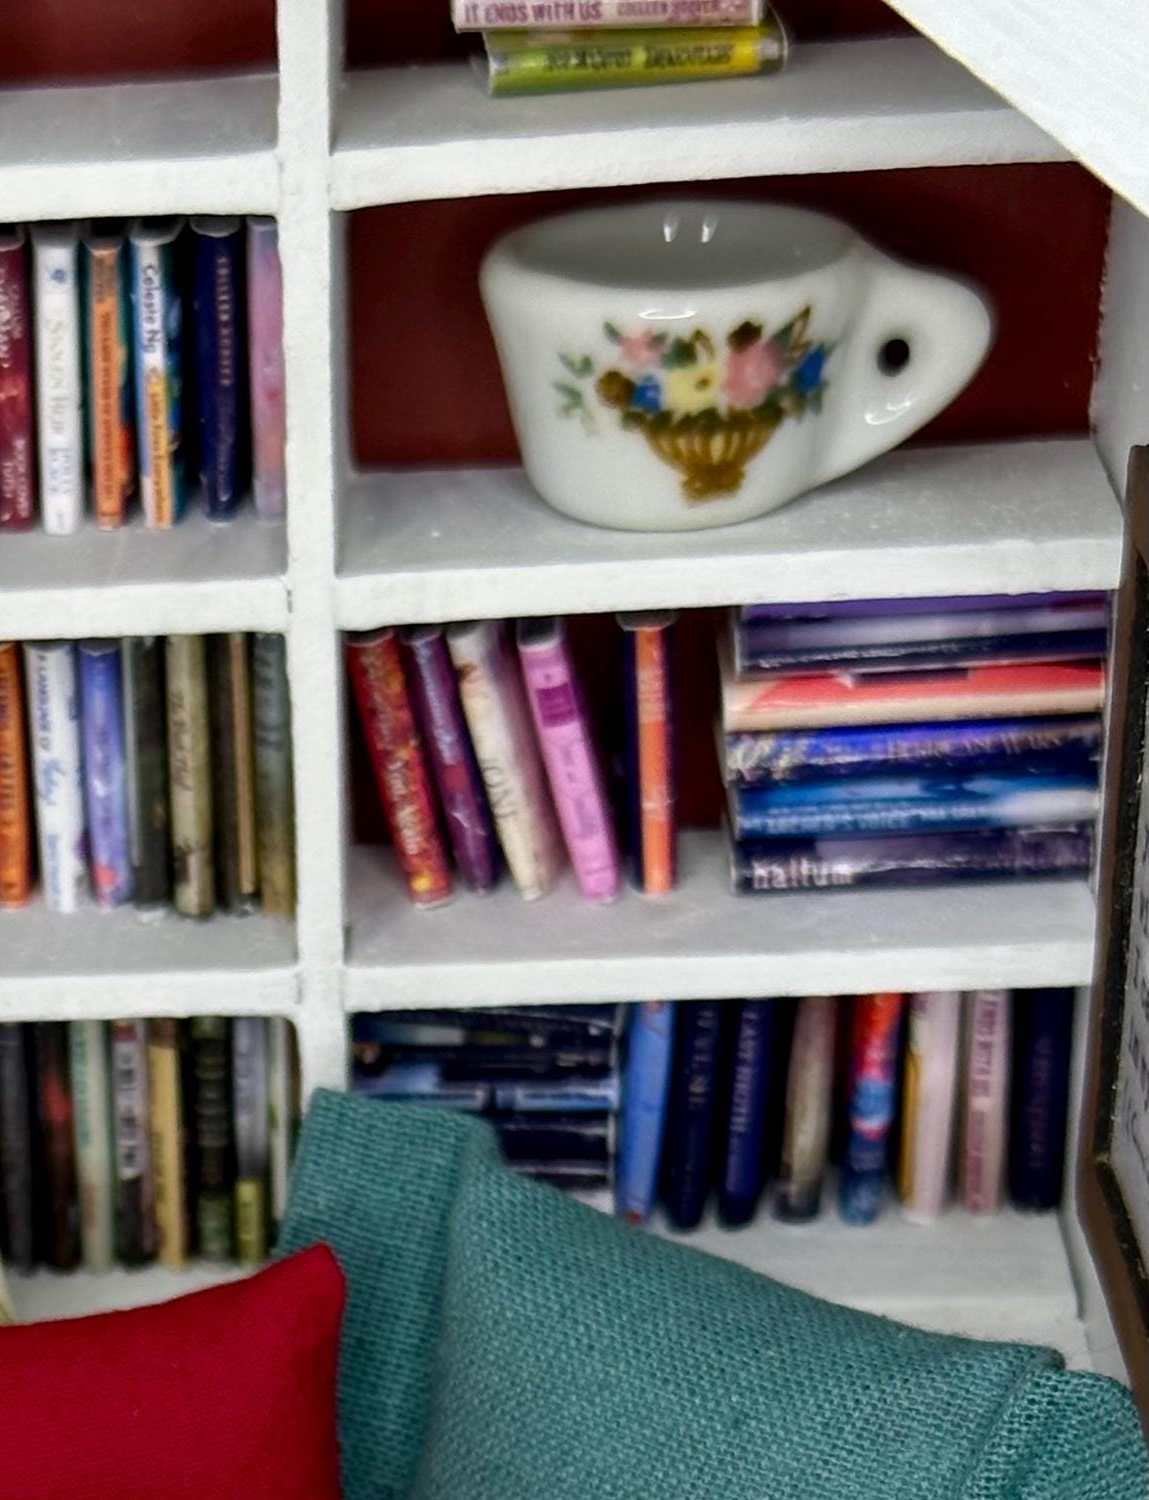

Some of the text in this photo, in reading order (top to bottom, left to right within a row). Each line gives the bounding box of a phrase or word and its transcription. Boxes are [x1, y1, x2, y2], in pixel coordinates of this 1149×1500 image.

[484, 1, 528, 22] ENDS
[532, 1, 575, 21] WITH
[579, 1, 604, 20] US
[140, 264, 160, 354] Celeste Ng
